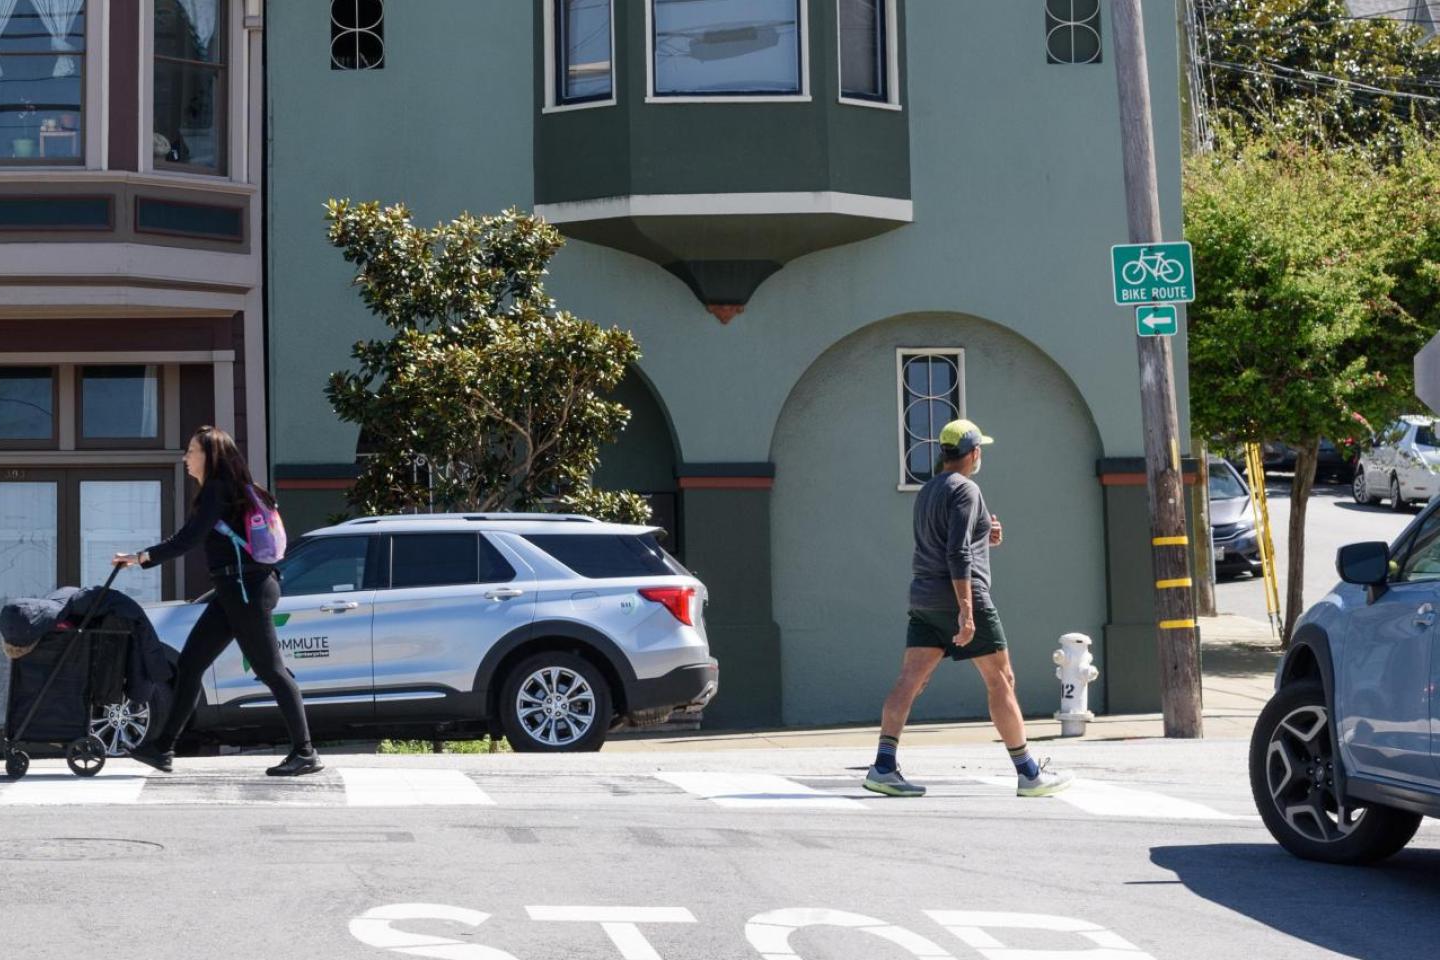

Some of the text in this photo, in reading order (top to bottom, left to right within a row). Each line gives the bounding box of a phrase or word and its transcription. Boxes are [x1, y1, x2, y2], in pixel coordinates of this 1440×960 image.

[1122, 286, 1187, 300] BIKE ROUTE
[275, 636, 329, 650] OMMUTE
